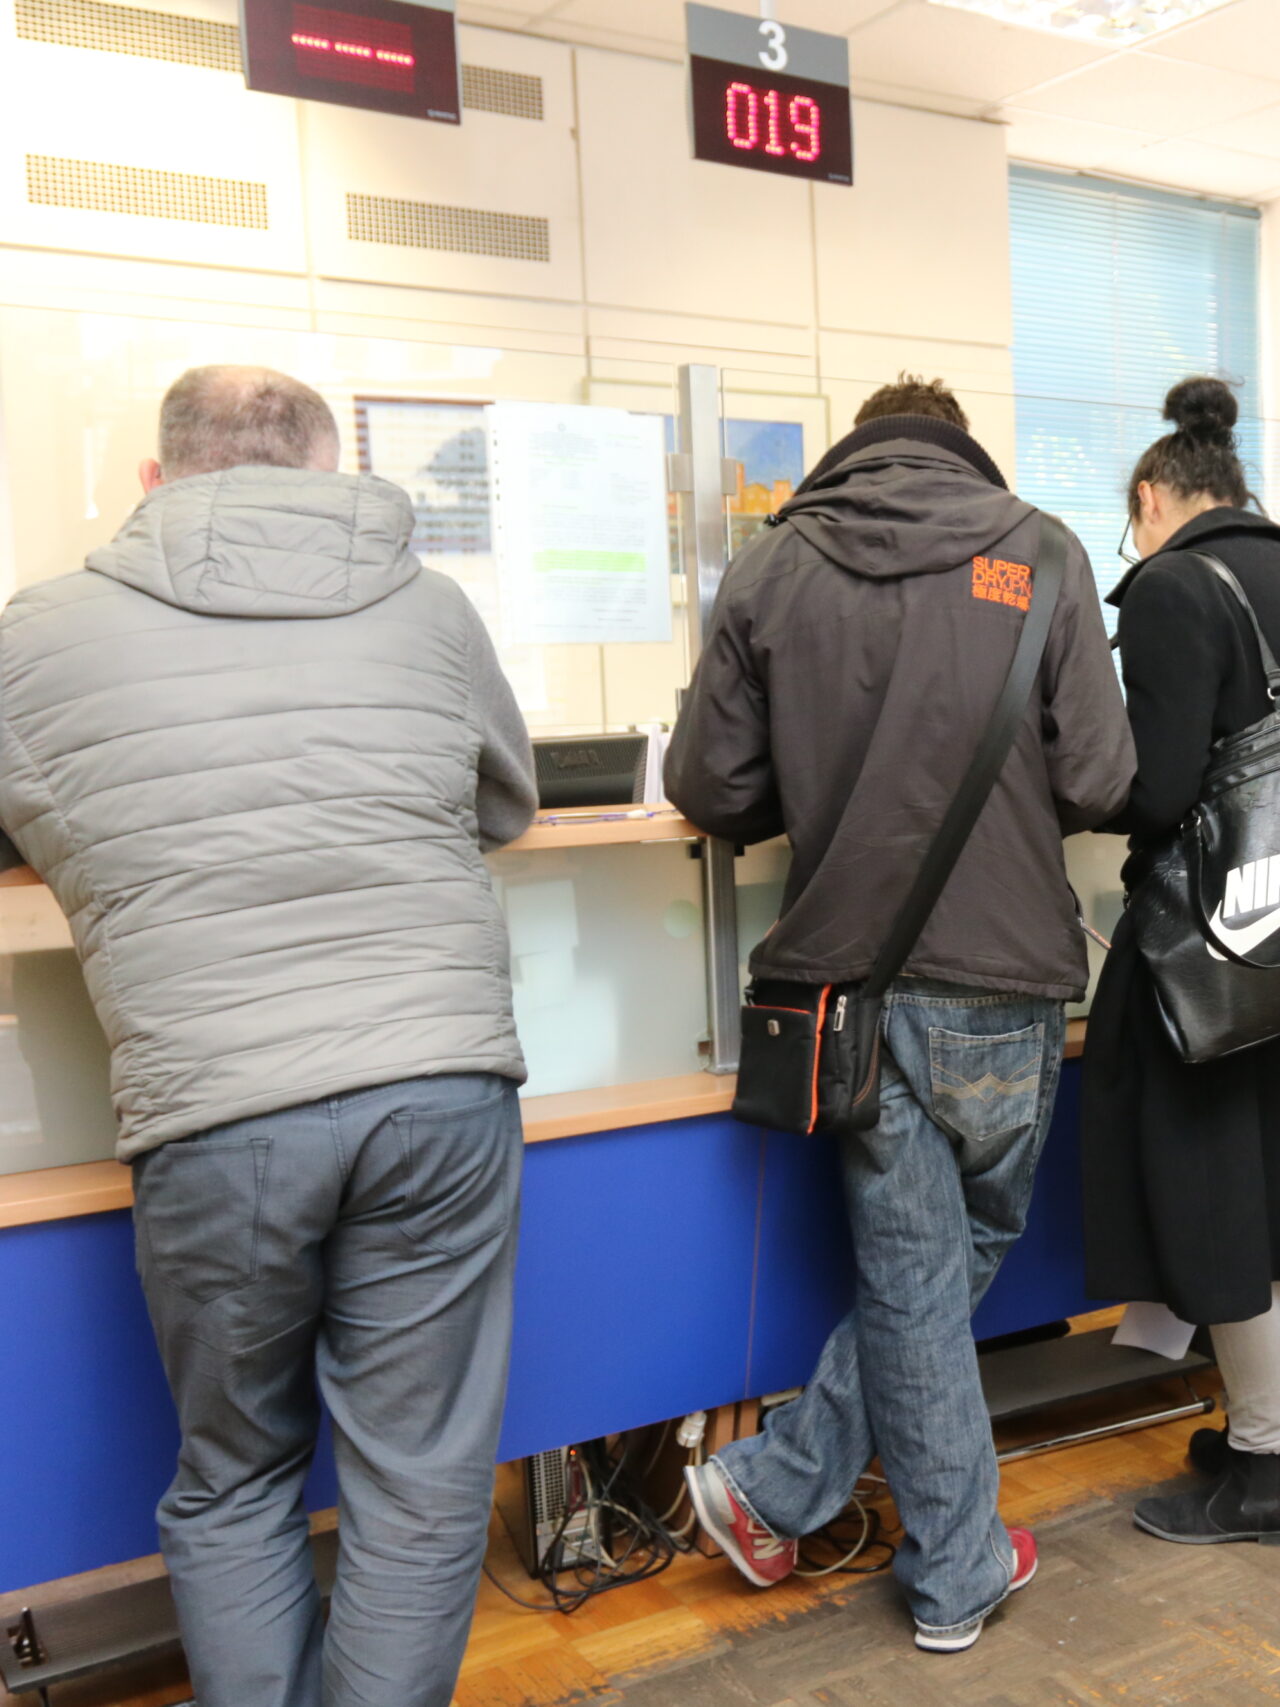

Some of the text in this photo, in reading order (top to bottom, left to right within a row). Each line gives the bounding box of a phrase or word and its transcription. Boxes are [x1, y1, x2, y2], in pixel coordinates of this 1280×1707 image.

[758, 20, 788, 71] 3
[726, 81, 820, 162] 019
[972, 555, 1031, 581] SUPER
